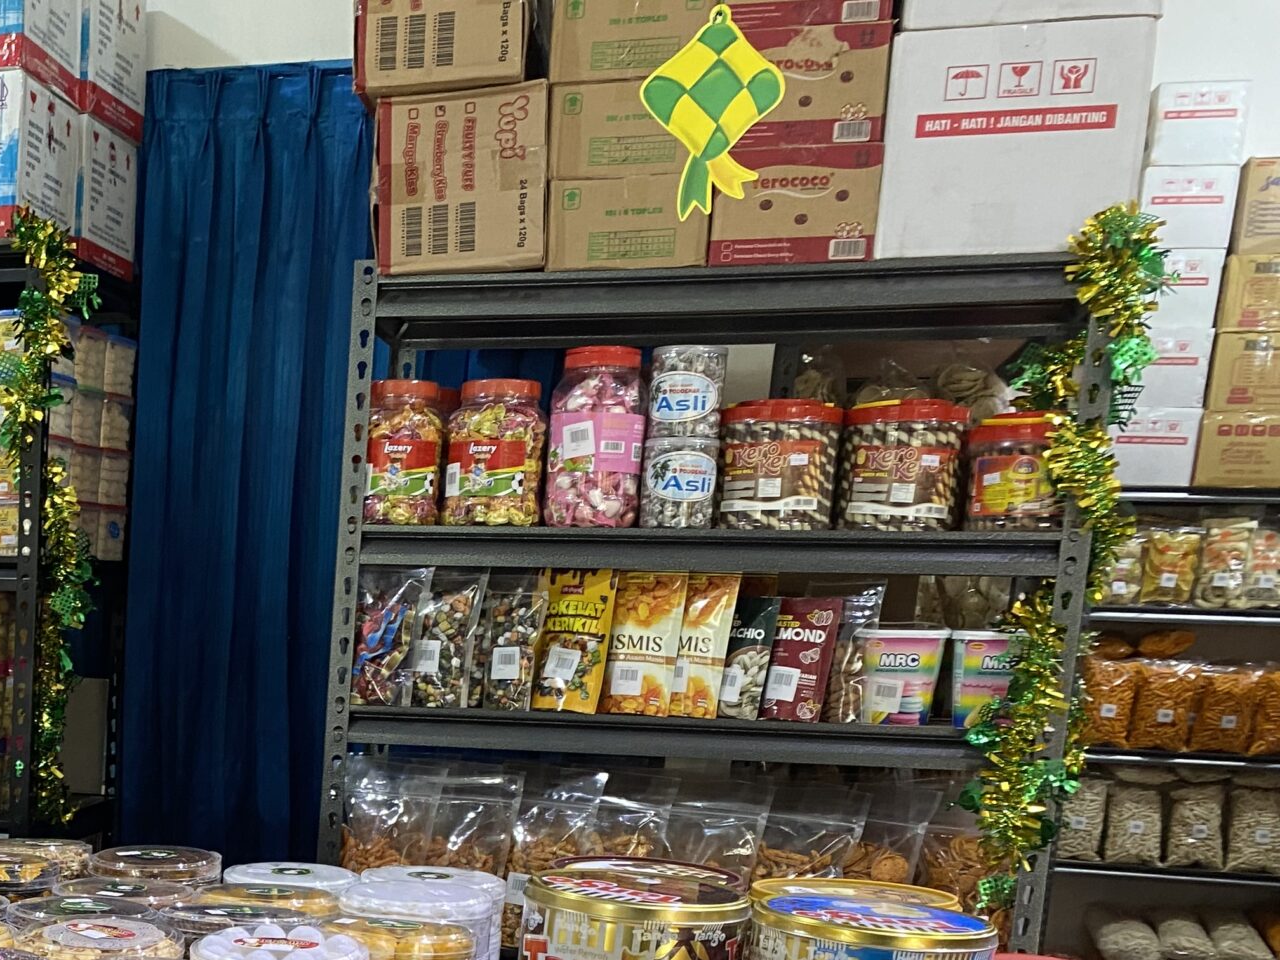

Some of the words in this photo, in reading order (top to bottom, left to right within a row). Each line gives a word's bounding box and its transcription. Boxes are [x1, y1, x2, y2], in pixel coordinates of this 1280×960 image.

[501, 1, 512, 27] Bags
[498, 39, 509, 62] 120g
[495, 95, 530, 161] Yupi
[925, 119, 950, 132] HATI
[961, 118, 987, 130] HATI
[996, 114, 1042, 128] JANGAN
[1045, 111, 1107, 125] DIBANTING
[403, 122, 420, 168] Mango
[431, 120, 448, 175] Strawberry
[405, 168, 418, 196] Kiss
[520, 179, 527, 191] 24
[518, 194, 527, 217] Bags
[517, 228, 527, 248] 120g
[656, 396, 707, 412] Asli
[736, 442, 781, 467] Kero
[870, 447, 918, 470] Kero
[662, 475, 711, 493] Asli
[880, 653, 920, 668] MRC
